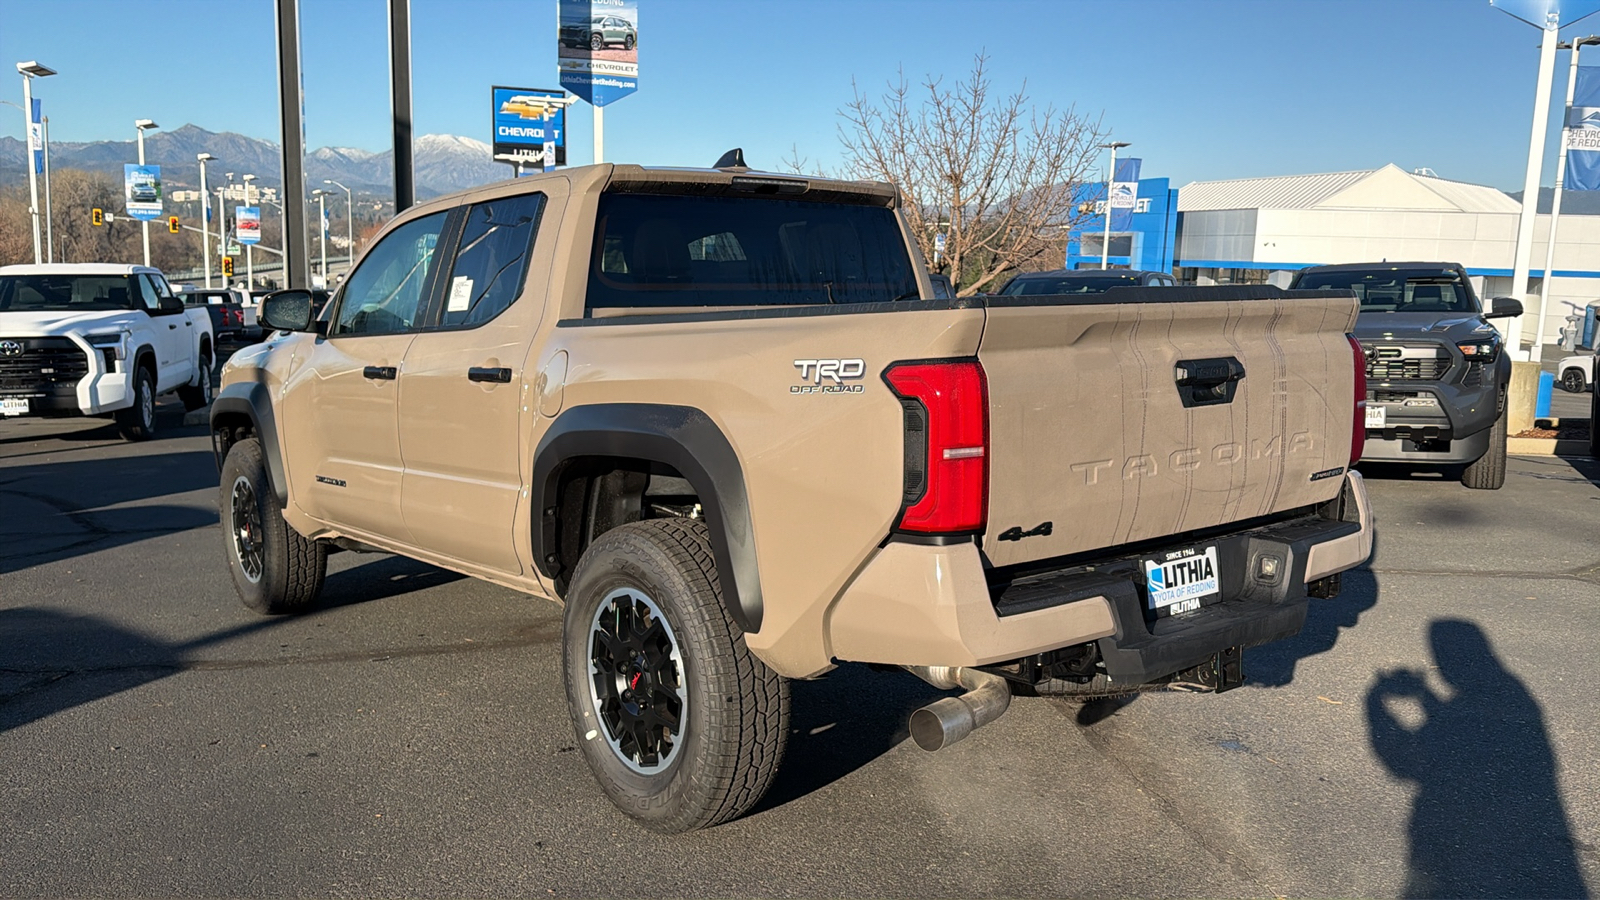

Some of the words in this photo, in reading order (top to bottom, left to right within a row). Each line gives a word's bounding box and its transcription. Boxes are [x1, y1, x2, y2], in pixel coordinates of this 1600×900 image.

[587, 62, 635, 72] CHEVROLET
[561, 75, 636, 88] LithiaChevroletRedding.com
[498, 126, 560, 139] CHEVROLT
[793, 358, 865, 384] TRD
[790, 385, 820, 395] OFF
[821, 384, 865, 395] ROAD
[1366, 410, 1383, 419] HIA
[1069, 428, 1315, 486] TACOMA
[1165, 550, 1182, 561] SINCE
[1163, 557, 1214, 589] LITHIA
[1149, 590, 1175, 603] TOYOTA
[1176, 587, 1185, 598] OF
[1186, 580, 1216, 596] REDDING
[1177, 598, 1201, 613] LITHIA
